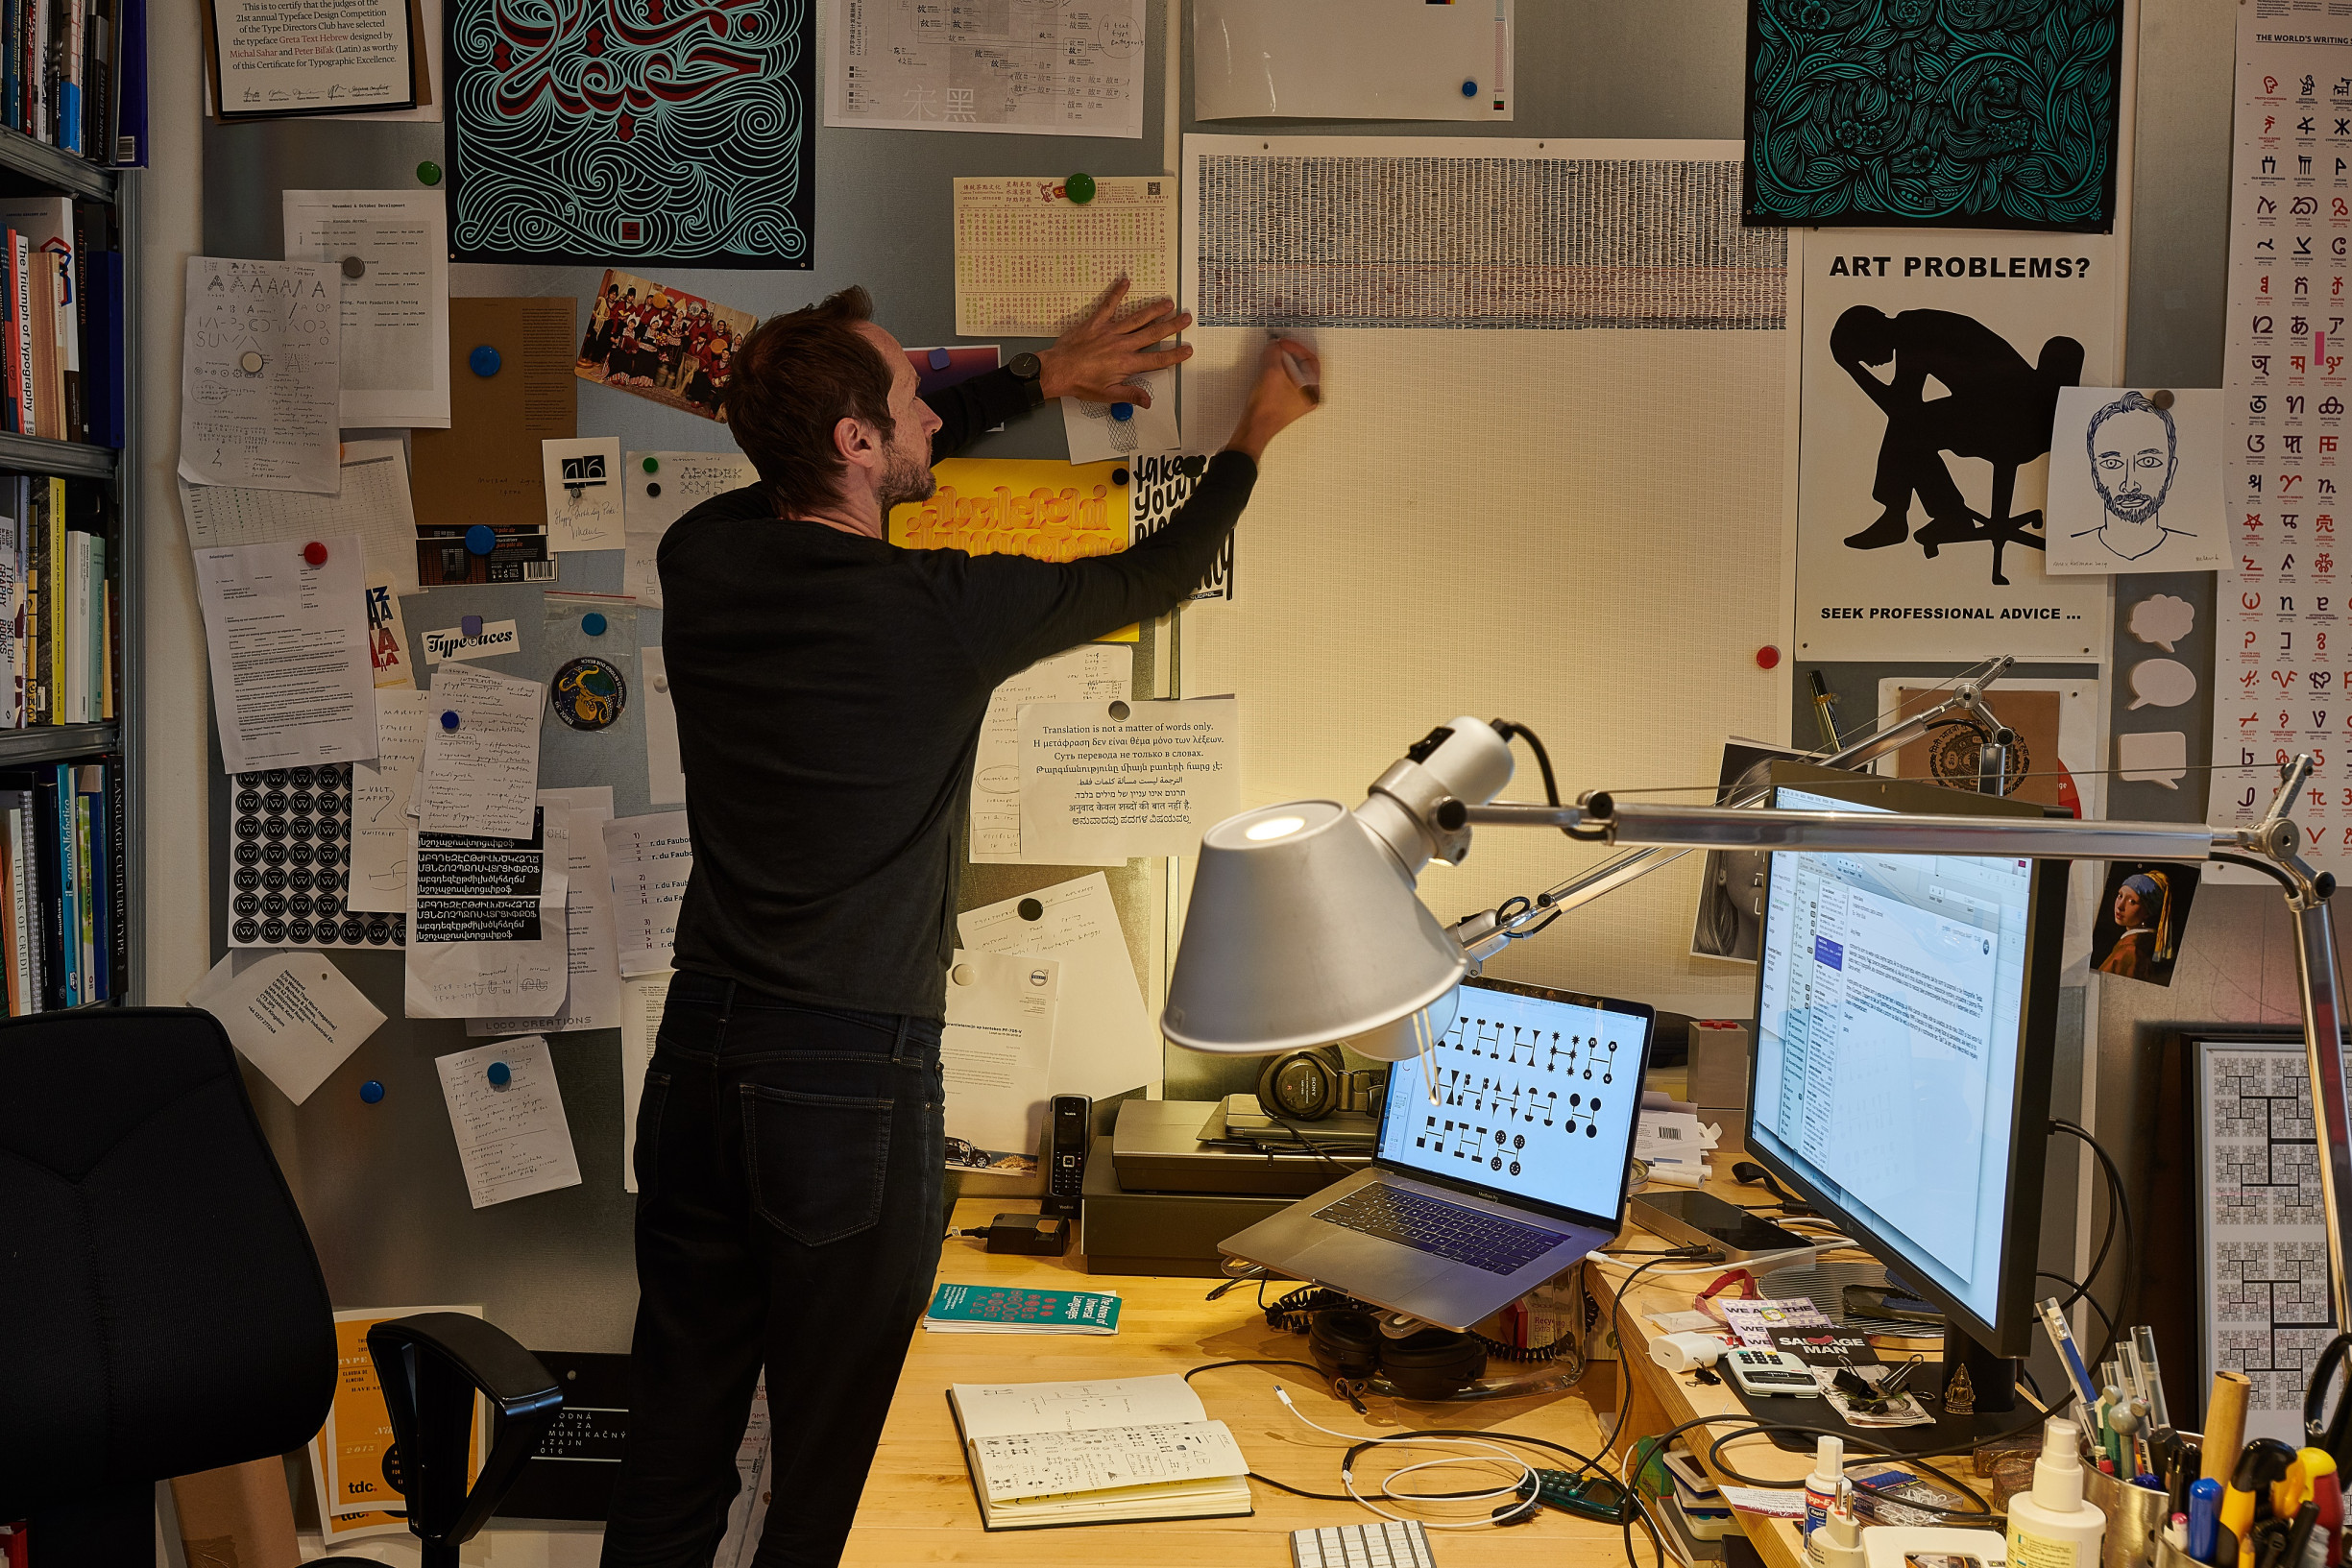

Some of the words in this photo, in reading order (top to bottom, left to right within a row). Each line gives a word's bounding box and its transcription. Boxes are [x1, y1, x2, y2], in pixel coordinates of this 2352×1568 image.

[279, 12, 312, 22] Typeface
[314, 11, 339, 20] Design
[341, 10, 386, 20] Competition
[233, 37, 245, 46] the
[247, 37, 278, 47] typeface
[350, 33, 382, 41] designed
[383, 32, 393, 40] by
[2274, 35, 2311, 43] WORLD'S
[2314, 36, 2349, 44] WRITING
[336, 44, 361, 53] (Latin)
[372, 43, 399, 52] worthy
[232, 61, 241, 70] of
[257, 60, 295, 68] Certificate
[297, 59, 306, 67] for
[308, 57, 356, 67] Typographic
[356, 55, 396, 64] Excellence.
[18, 243, 28, 266] The
[1830, 255, 1892, 277] ART
[1904, 255, 2091, 279] PROBLEMS?
[19, 269, 30, 323] Triumph
[22, 324, 31, 339] of
[22, 340, 34, 413] Typography
[1821, 607, 1865, 620] SEEK
[1869, 607, 1995, 620] PROFESSIONAL
[1999, 608, 2061, 620] ADVICE
[1194, 722, 1213, 732] only.
[1043, 737, 1090, 749] μετάφραση
[1092, 737, 1106, 746] δεν
[1108, 736, 1128, 745] είναι
[1130, 736, 1151, 746] θέμα
[1152, 737, 1173, 746] μόνο
[1193, 736, 1224, 744] λέξεων.
[1078, 752, 1117, 760] перевода
[113, 777, 123, 852] LANGUAGE
[1069, 804, 1094, 814] अनुवाद
[1096, 803, 1116, 811] केवल
[1119, 801, 1138, 810] शब्दों
[1139, 801, 1149, 810] की
[1168, 800, 1182, 809] नहीं
[14, 858, 24, 910] LETTERS
[115, 855, 124, 917] CULTURE
[18, 916, 26, 931] OF
[116, 921, 125, 956] TYPE
[18, 934, 28, 978] CREDIT
[283, 969, 305, 991] Newsstand
[286, 980, 301, 994] Works
[299, 992, 309, 1002] That
[306, 1001, 319, 1012] Work
[255, 997, 269, 1011] United
[267, 1009, 285, 1027] Kingdom
[283, 994, 300, 1009] Joseph
[297, 1006, 312, 1021] Wilson
[283, 1009, 295, 1020] Kent
[522, 1017, 592, 1027] CREATIONS
[1779, 1337, 1865, 1346] SAAGE
[1804, 1345, 1849, 1355] MAN
[348, 1481, 377, 1493] tdc.
[1806, 1489, 1835, 1507] Tipp-E
